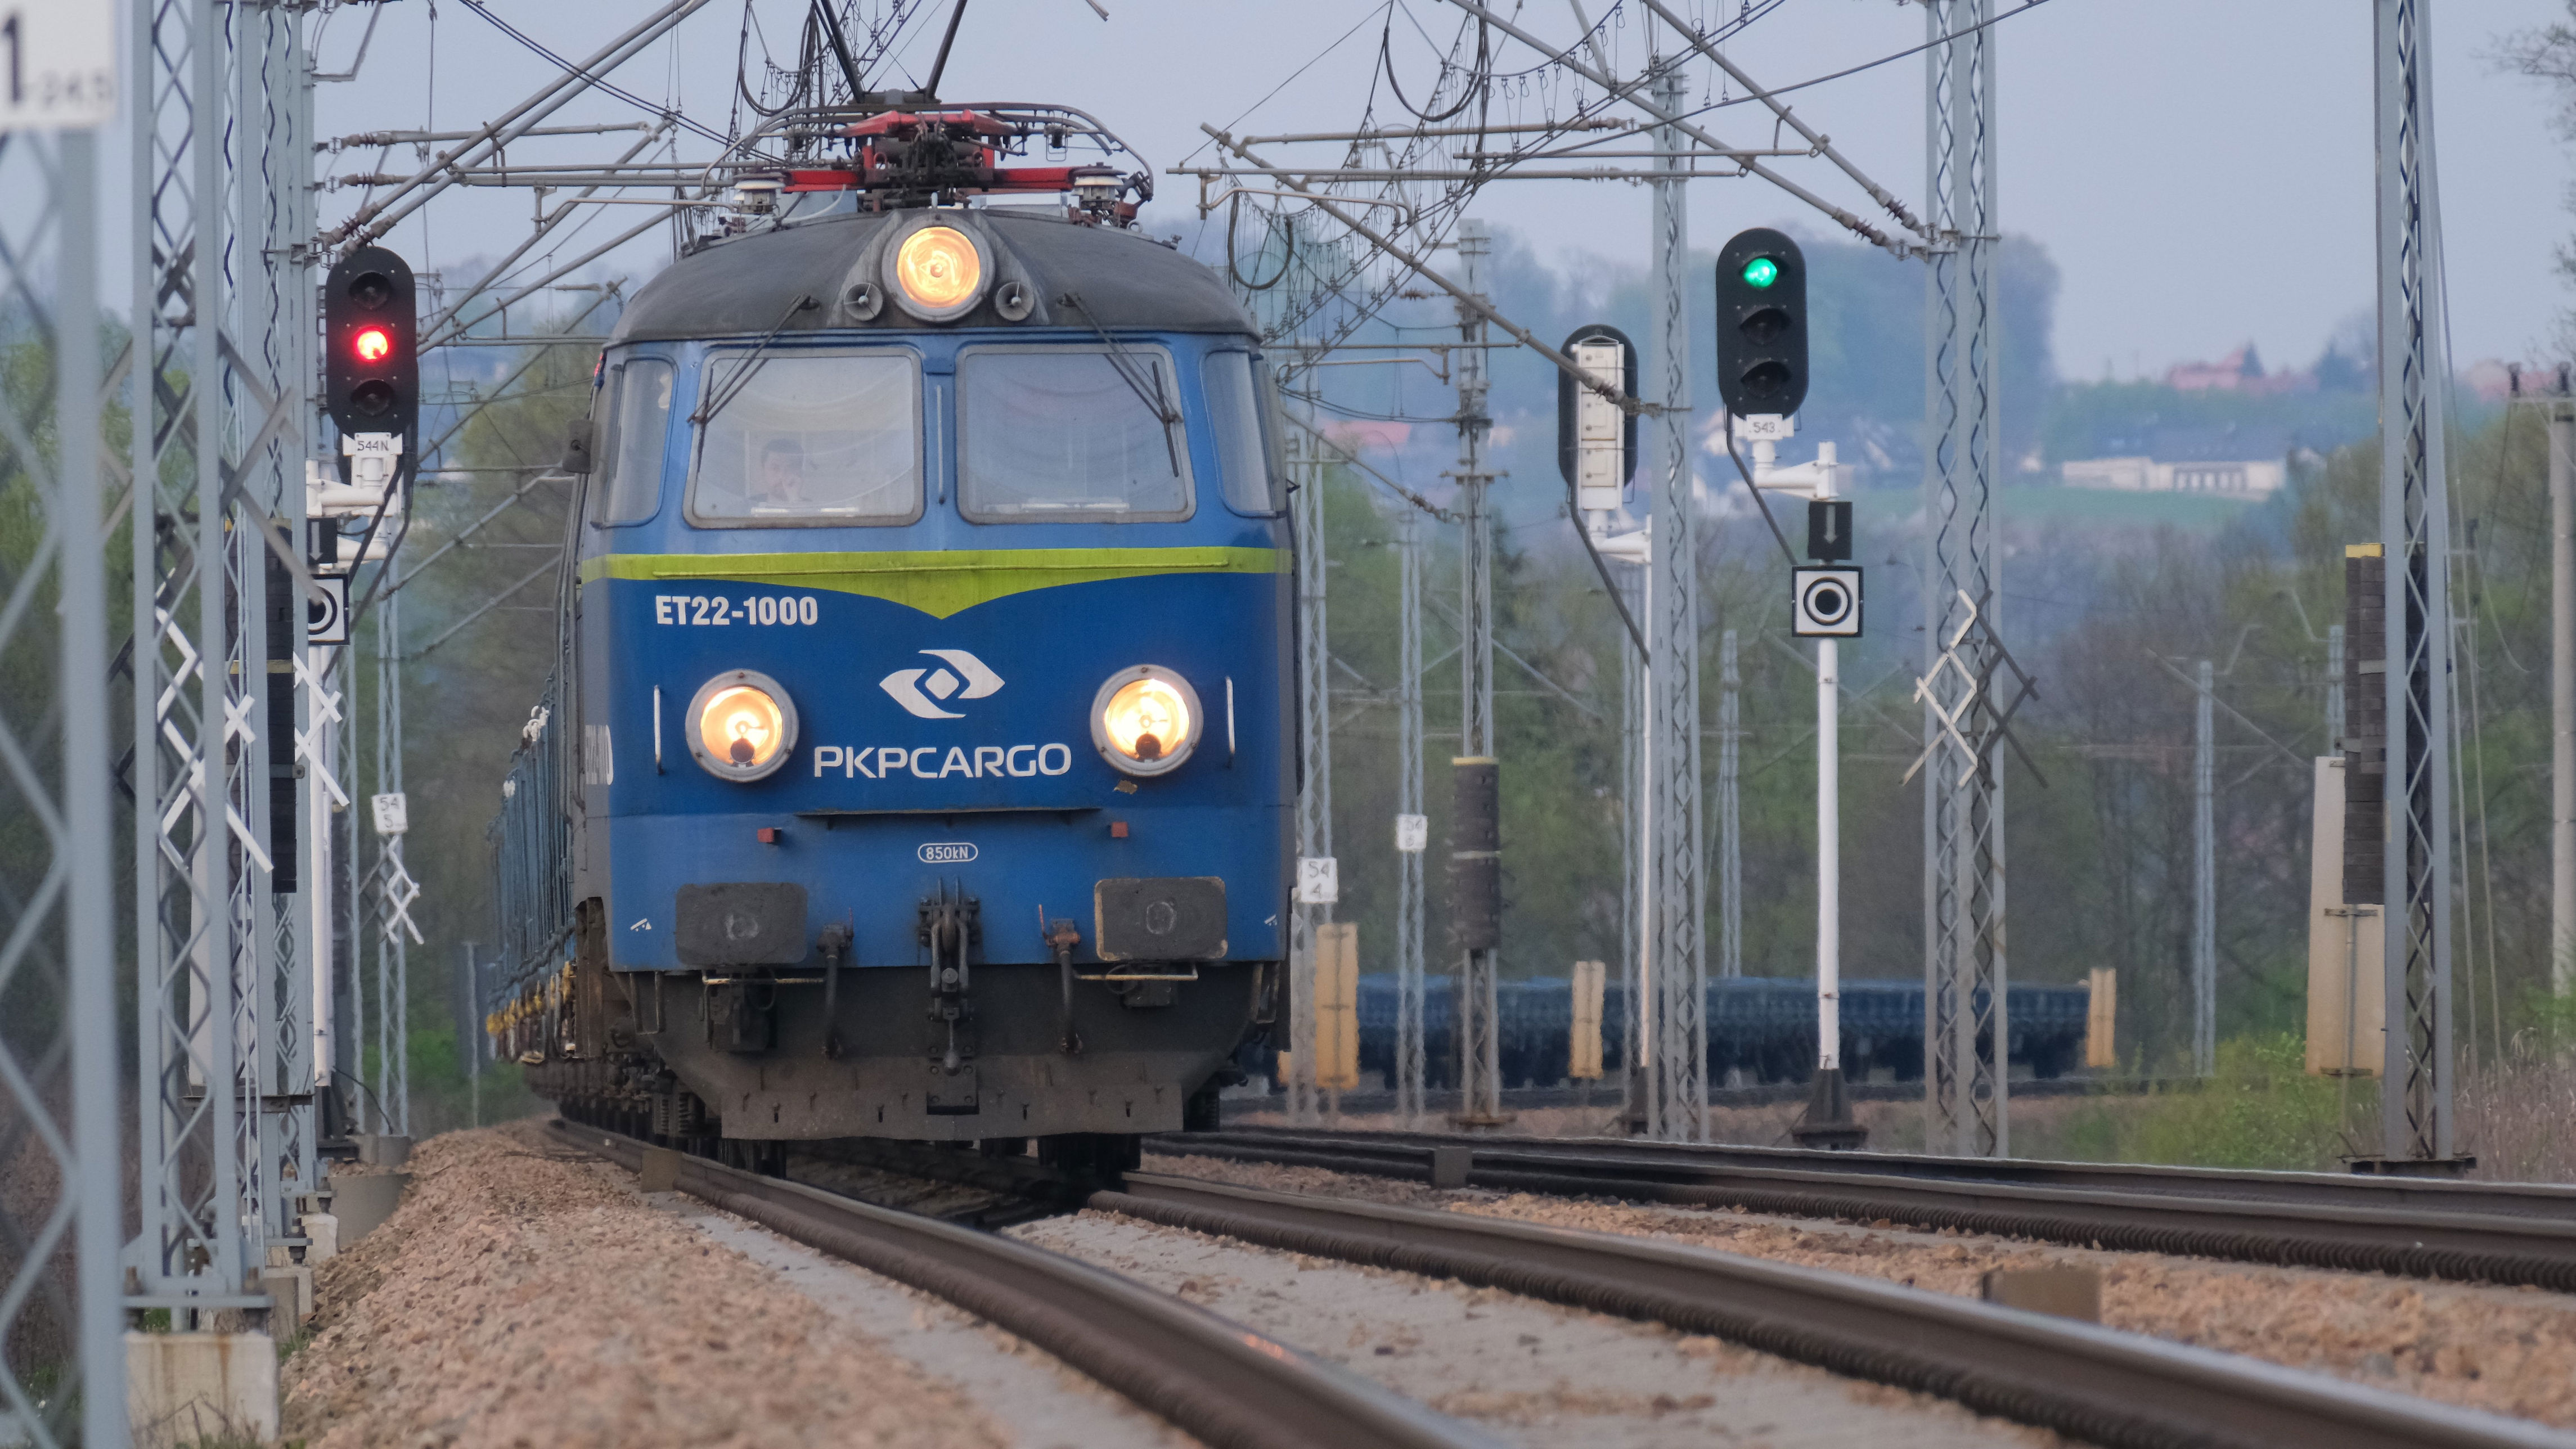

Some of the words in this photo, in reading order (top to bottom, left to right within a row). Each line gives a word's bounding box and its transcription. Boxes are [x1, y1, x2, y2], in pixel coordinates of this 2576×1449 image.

[1753, 421, 1775, 433] 543
[357, 440, 389, 451] 544N
[655, 595, 818, 626] ET22-1000
[813, 742, 1072, 778] PKPCARGO
[926, 846, 968, 860] 850kN
